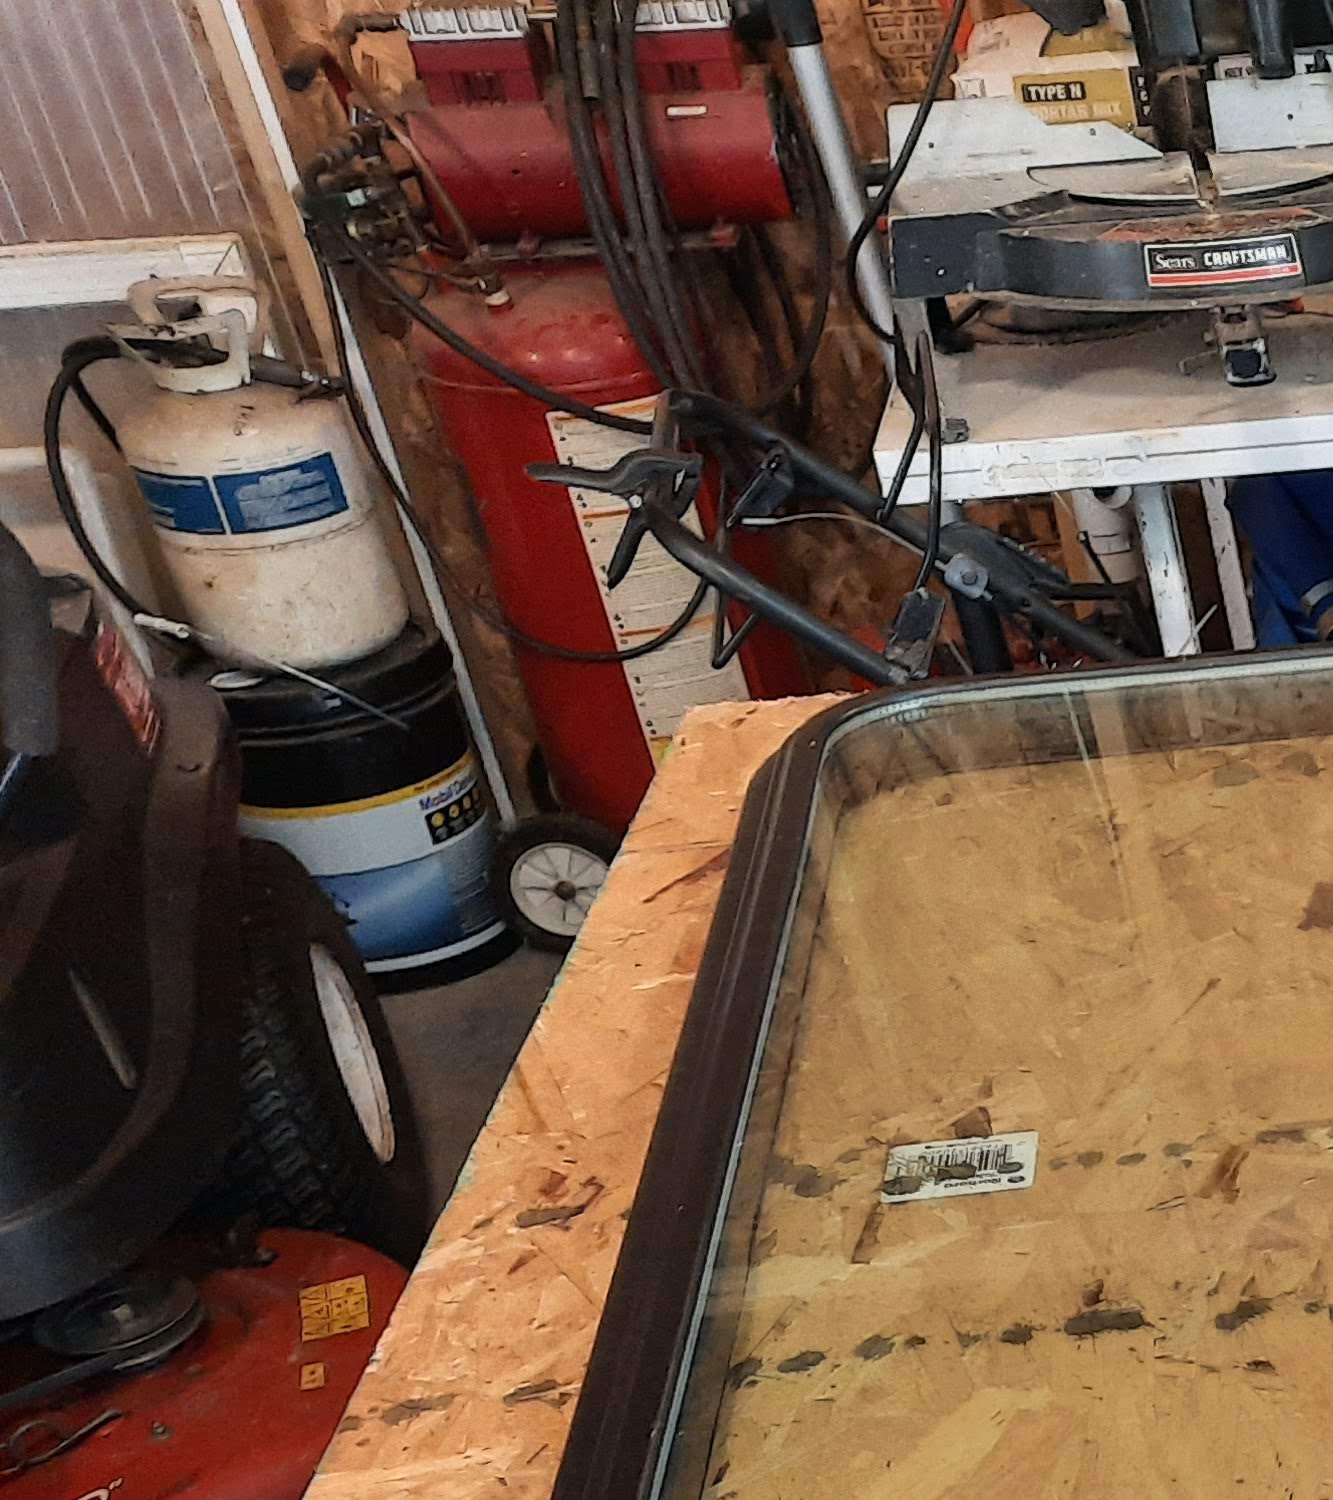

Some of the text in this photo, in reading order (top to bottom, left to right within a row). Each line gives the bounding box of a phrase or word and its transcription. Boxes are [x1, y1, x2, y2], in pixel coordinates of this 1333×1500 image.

[1028, 83, 1082, 101] TYPE N
[1032, 103, 1090, 120] ORTAR
[1155, 244, 1287, 270] Sears CRAFTSMAN
